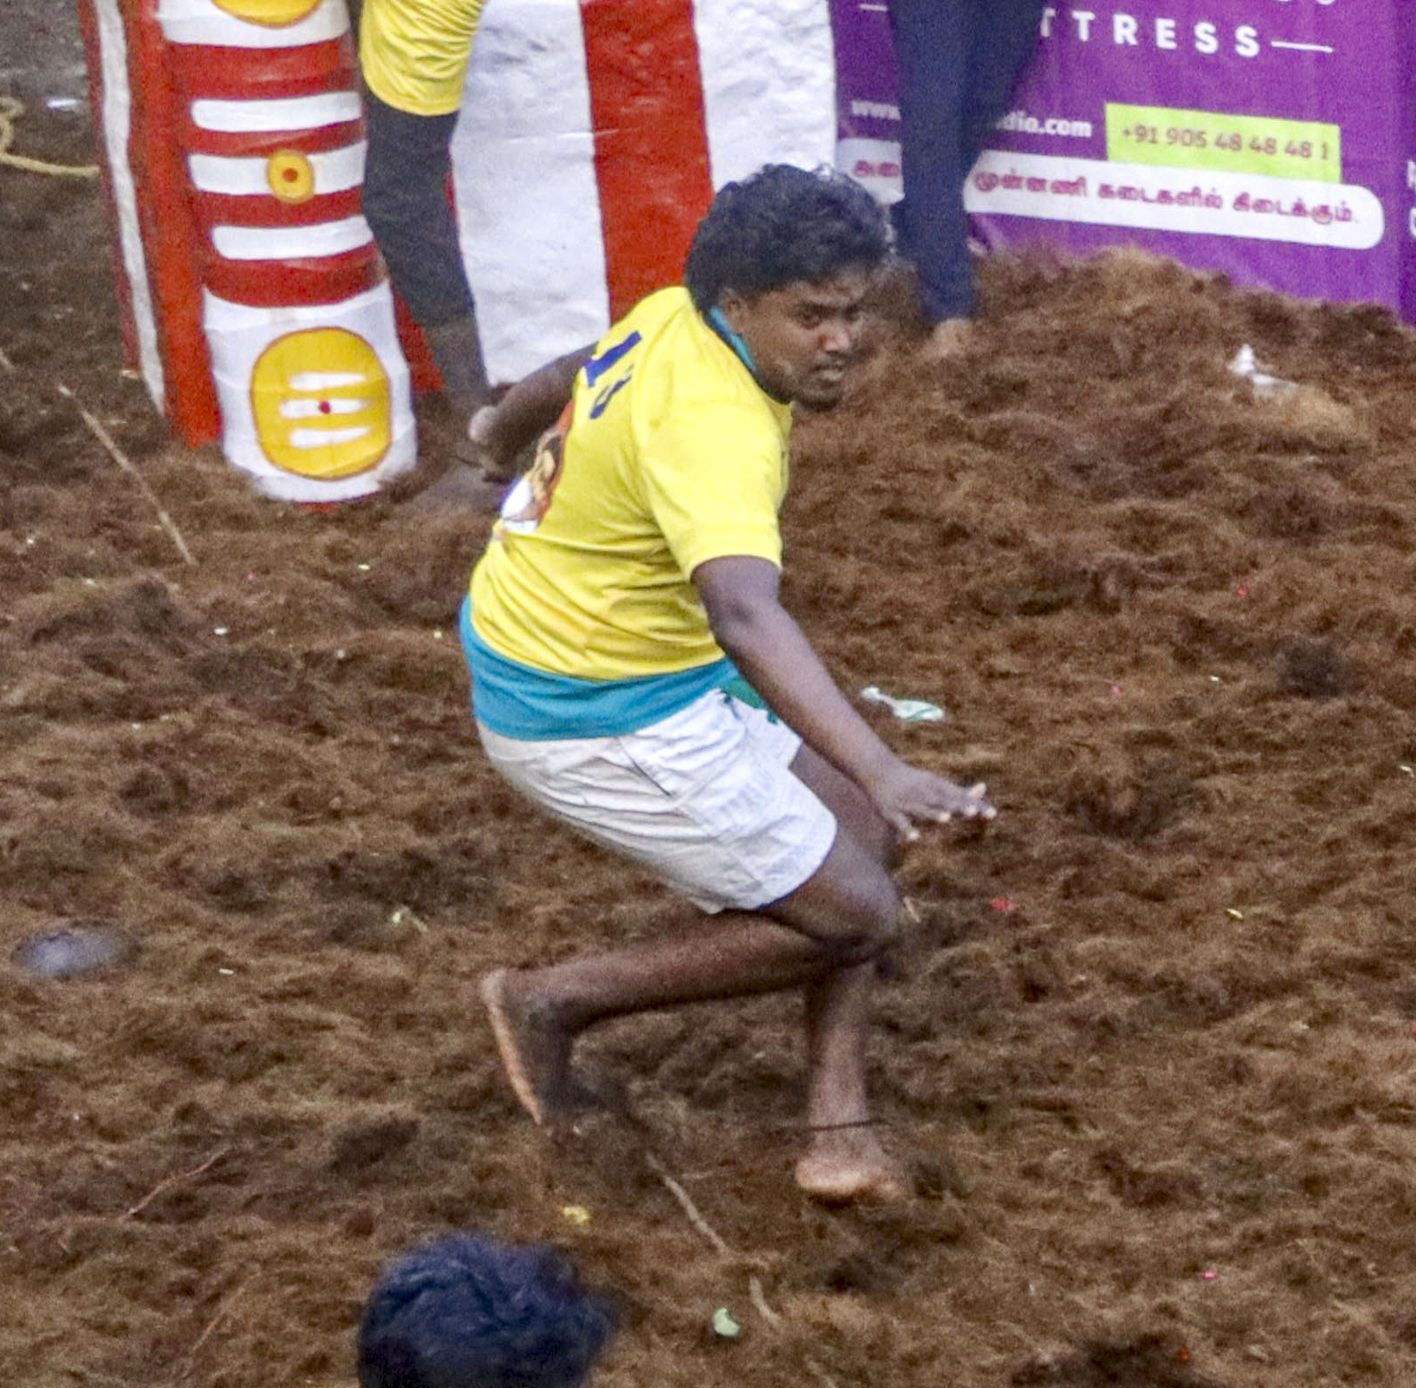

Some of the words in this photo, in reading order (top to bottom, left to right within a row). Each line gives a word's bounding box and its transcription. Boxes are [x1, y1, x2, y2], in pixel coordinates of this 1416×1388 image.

[1040, 8, 1260, 57] TTRESS
[1122, 124, 1158, 145] +91
[1166, 127, 1207, 149] 905
[1214, 132, 1242, 151] 48
[1249, 136, 1277, 155] 48
[1284, 140, 1312, 159] 48
[1321, 142, 1329, 160] 1
